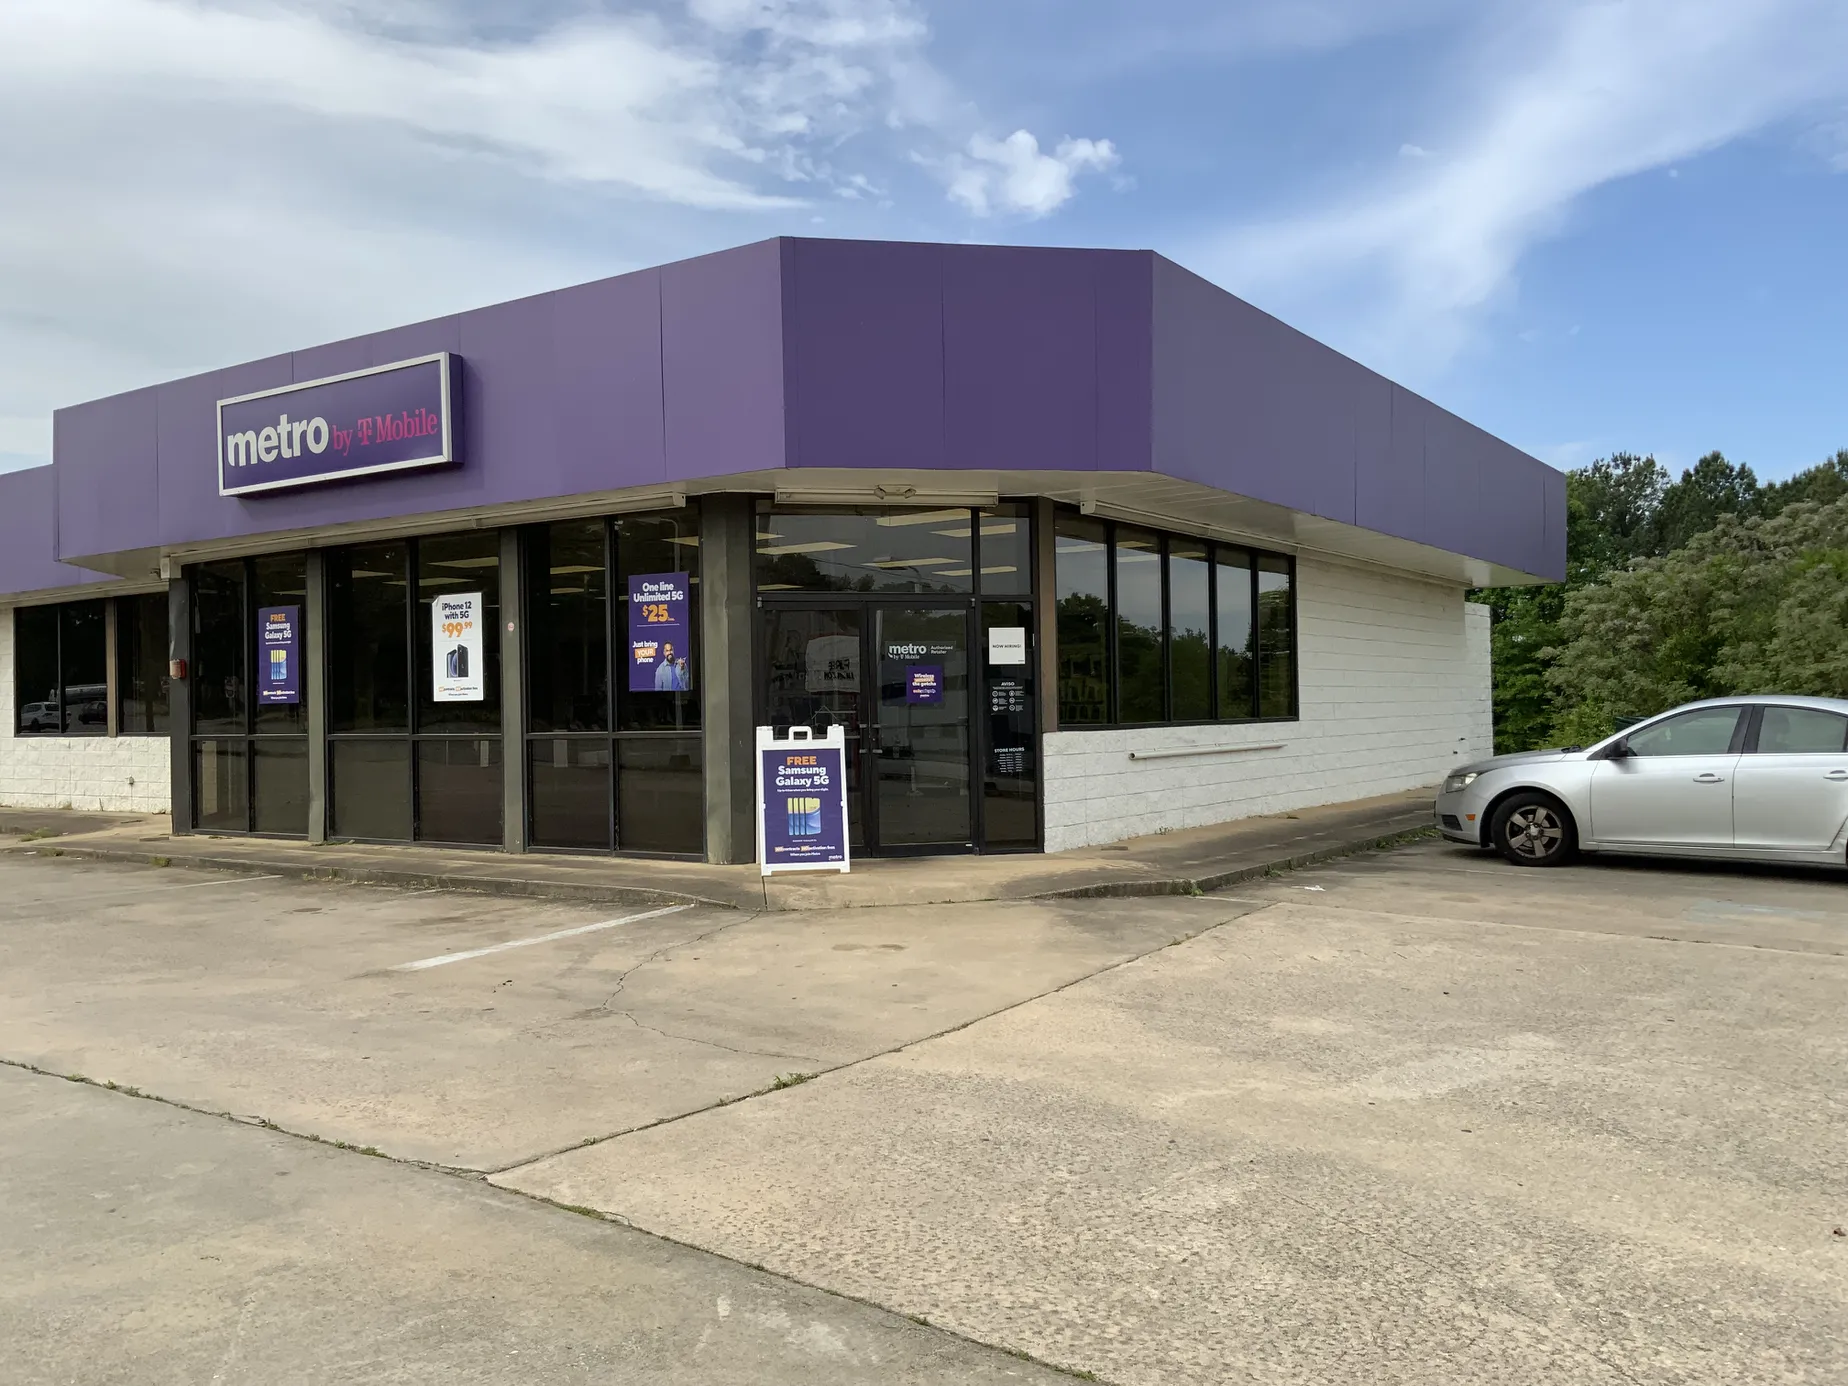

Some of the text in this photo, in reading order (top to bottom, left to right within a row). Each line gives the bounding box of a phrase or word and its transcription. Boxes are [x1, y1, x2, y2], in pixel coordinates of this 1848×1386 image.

[227, 413, 329, 467] metro
[332, 424, 353, 456] by
[375, 408, 438, 443] Mobile
[642, 581, 674, 592] One line
[633, 590, 684, 603] Unlimited 5G
[442, 601, 472, 611] iPhone 12
[270, 613, 286, 622] FREE
[445, 610, 470, 620] with 5G
[266, 622, 291, 631] Samsung
[265, 630, 292, 640] Galaxy 5G
[632, 640, 658, 649] Just bring
[888, 643, 927, 654] metro
[637, 656, 654, 665] phone
[786, 756, 817, 765] FREE
[778, 765, 826, 776] Samsung
[775, 775, 830, 787] Galaxy 5G
